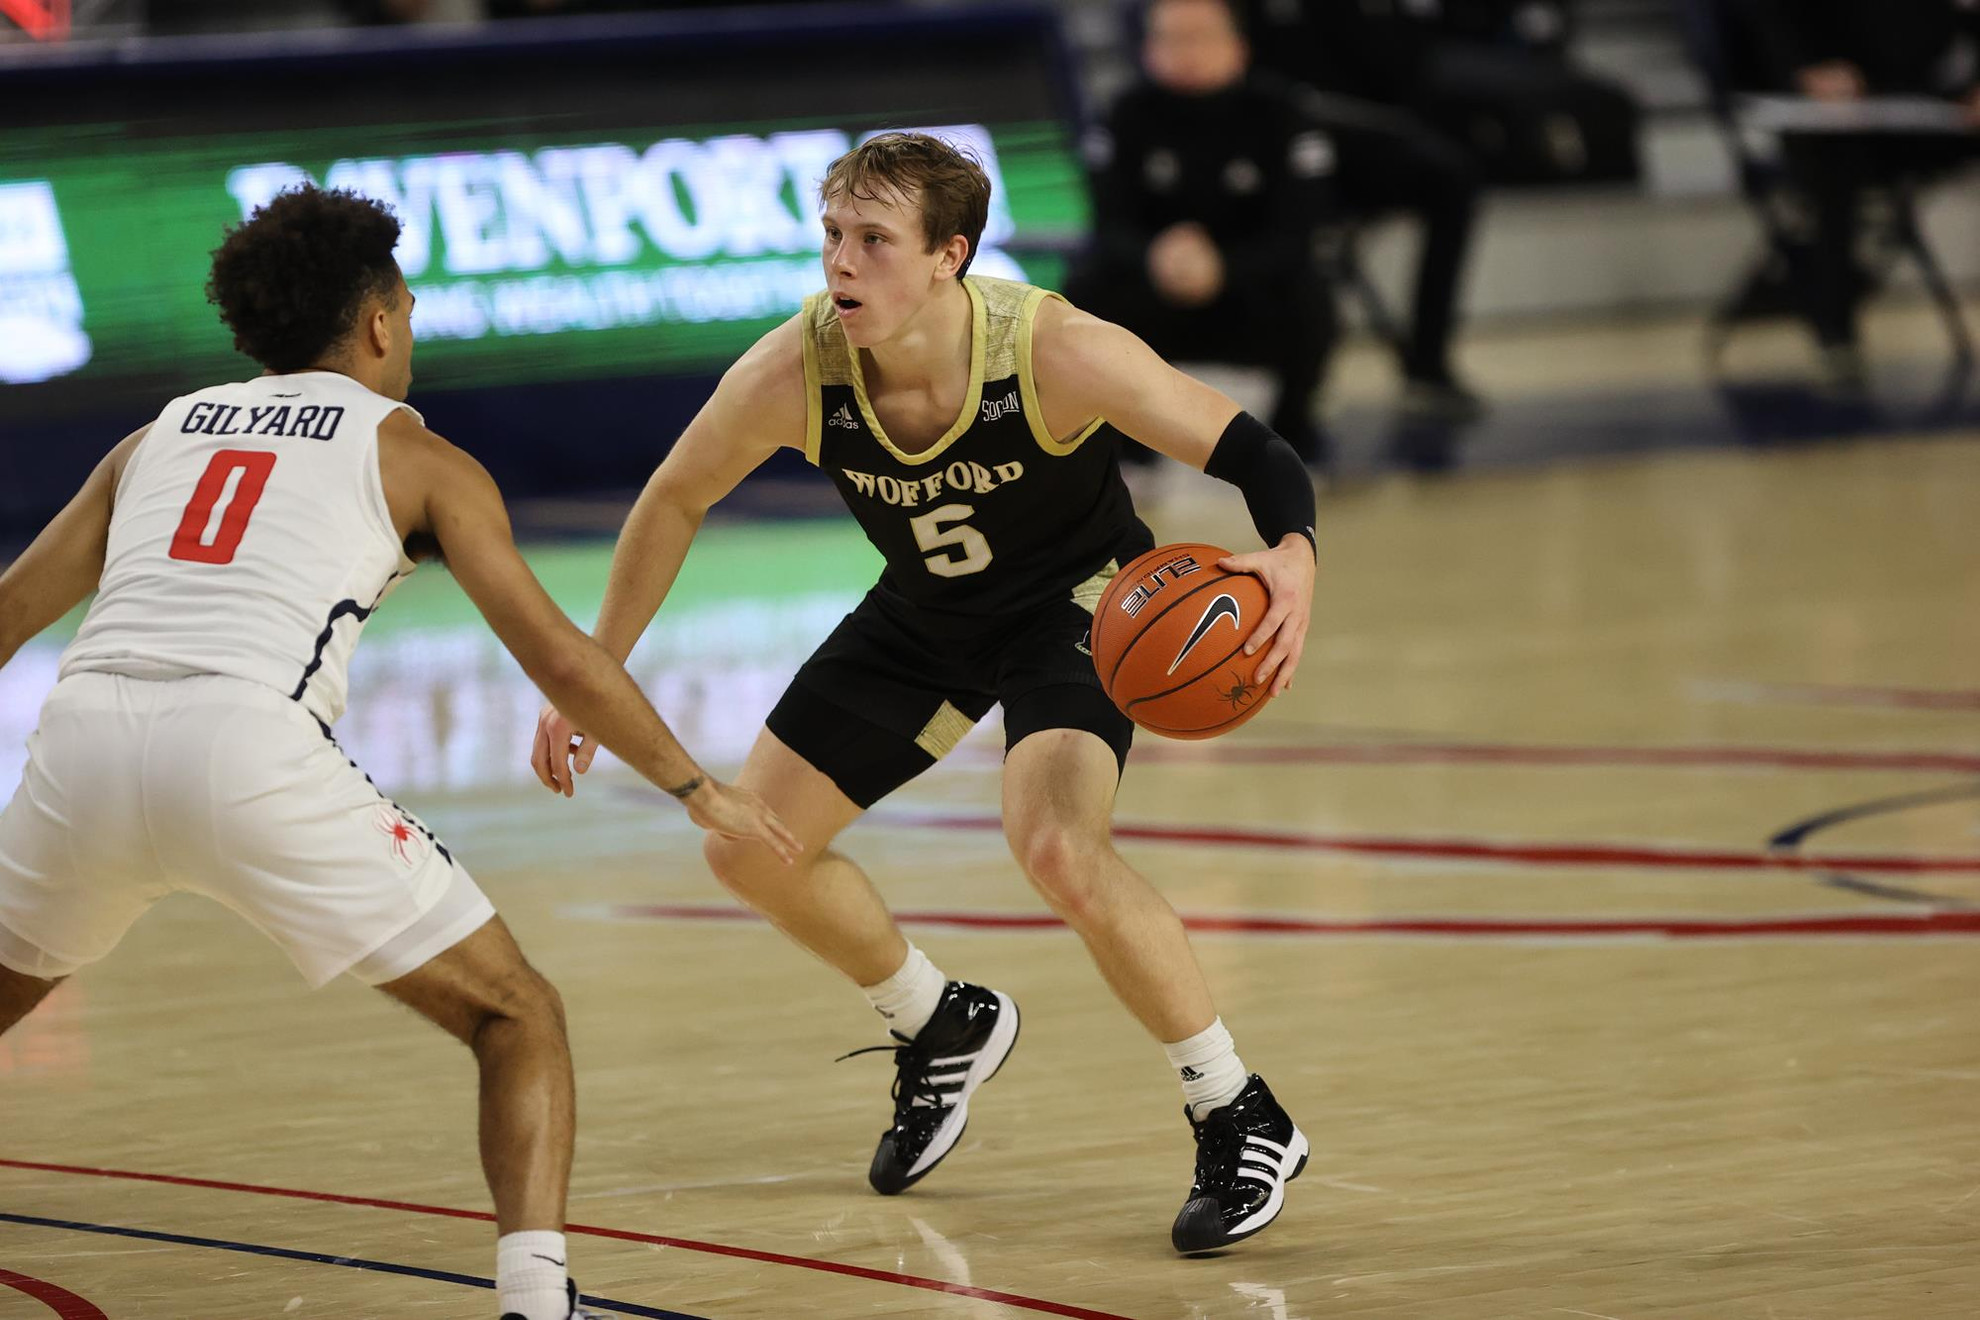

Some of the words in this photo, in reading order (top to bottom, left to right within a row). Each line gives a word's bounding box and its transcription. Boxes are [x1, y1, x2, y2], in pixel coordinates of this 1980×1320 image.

[225, 128, 850, 280] VENPORT
[180, 402, 345, 441] GILYARD
[168, 449, 277, 565] 0
[842, 461, 1024, 507] WOFFORD
[909, 503, 993, 578] 5
[1120, 556, 1201, 619] ELITE
